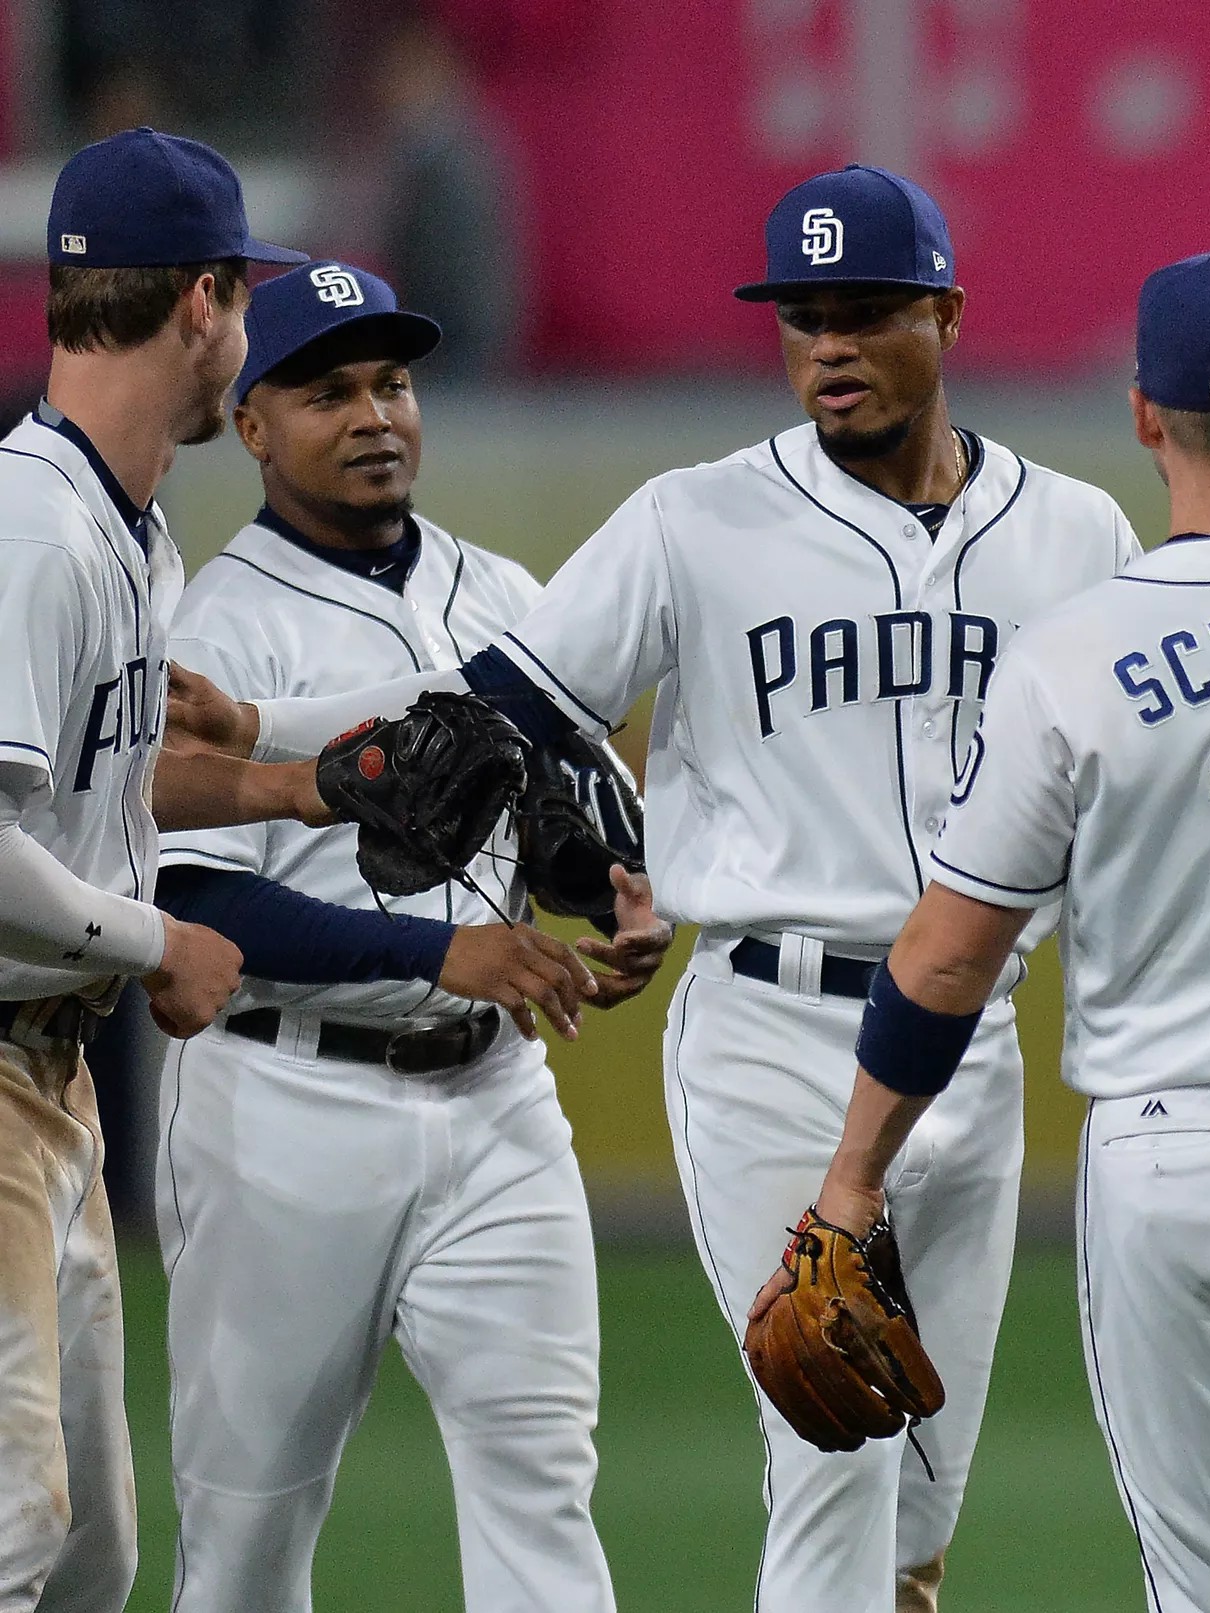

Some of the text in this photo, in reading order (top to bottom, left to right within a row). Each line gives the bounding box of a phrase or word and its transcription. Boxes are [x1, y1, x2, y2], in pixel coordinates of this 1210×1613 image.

[802, 208, 844, 266] SD
[309, 265, 364, 308] SD
[746, 609, 998, 741] PADR
